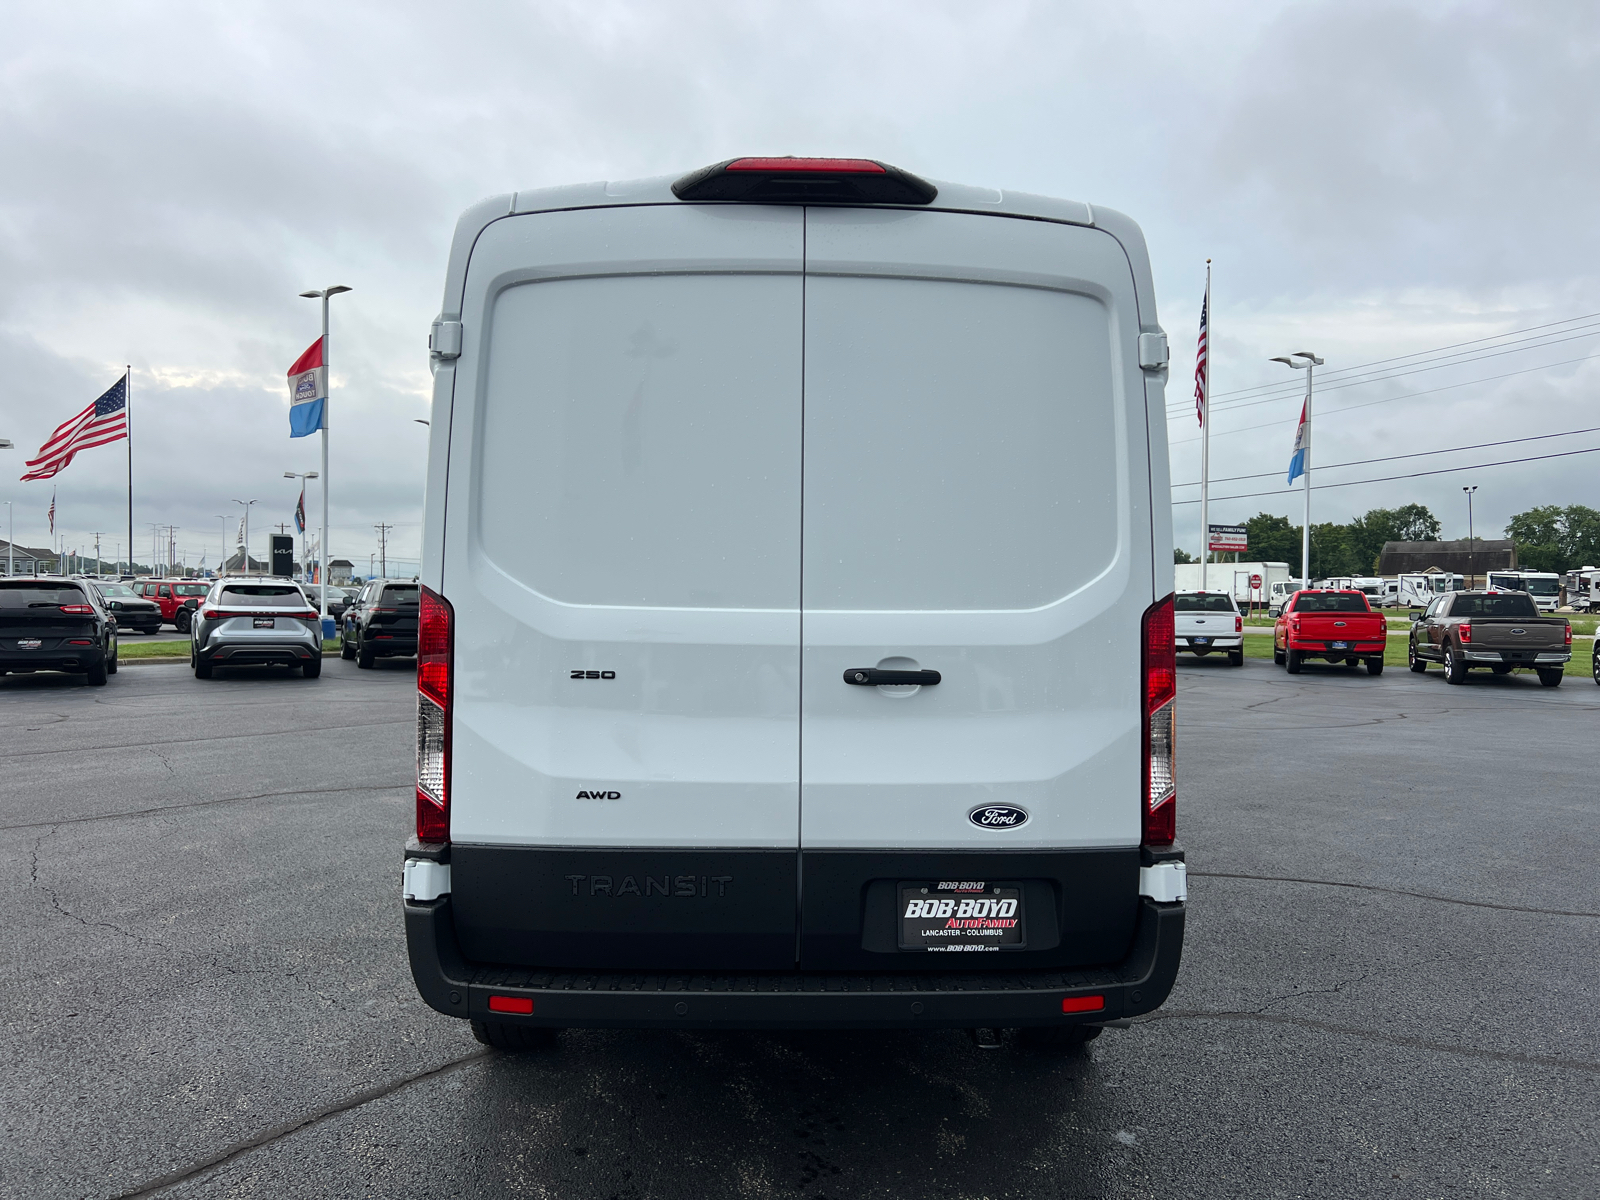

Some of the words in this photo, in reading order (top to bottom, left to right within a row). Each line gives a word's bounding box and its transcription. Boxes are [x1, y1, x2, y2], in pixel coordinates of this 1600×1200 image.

[570, 670, 616, 680] 250
[576, 790, 622, 800] AWD
[981, 808, 1018, 825] Ford
[564, 874, 734, 898] TRANSIT
[921, 929, 961, 937] LANCASTER
